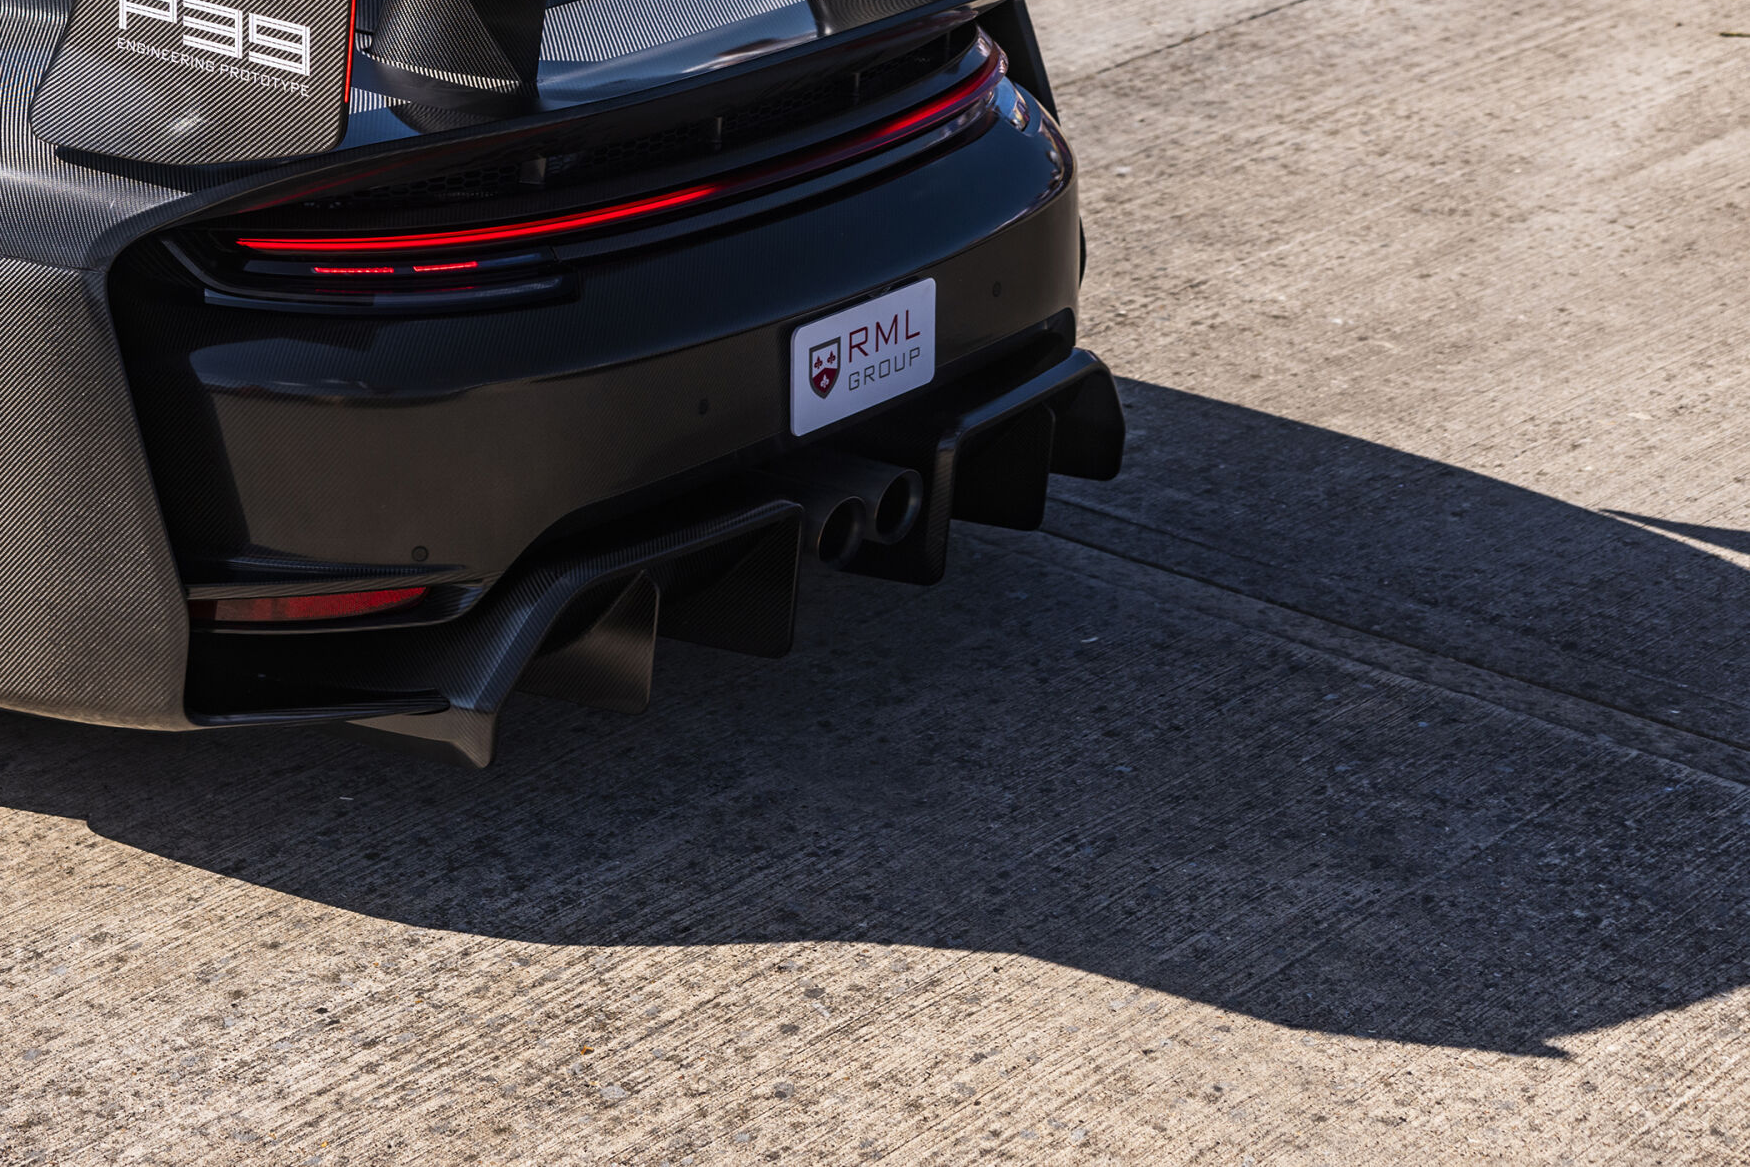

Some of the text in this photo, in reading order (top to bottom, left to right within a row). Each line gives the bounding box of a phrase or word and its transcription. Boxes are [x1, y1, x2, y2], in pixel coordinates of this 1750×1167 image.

[116, 36, 310, 98] ENGINEERING PROTOTYPE
[848, 309, 921, 363] RML
[848, 346, 921, 392] GROUP
